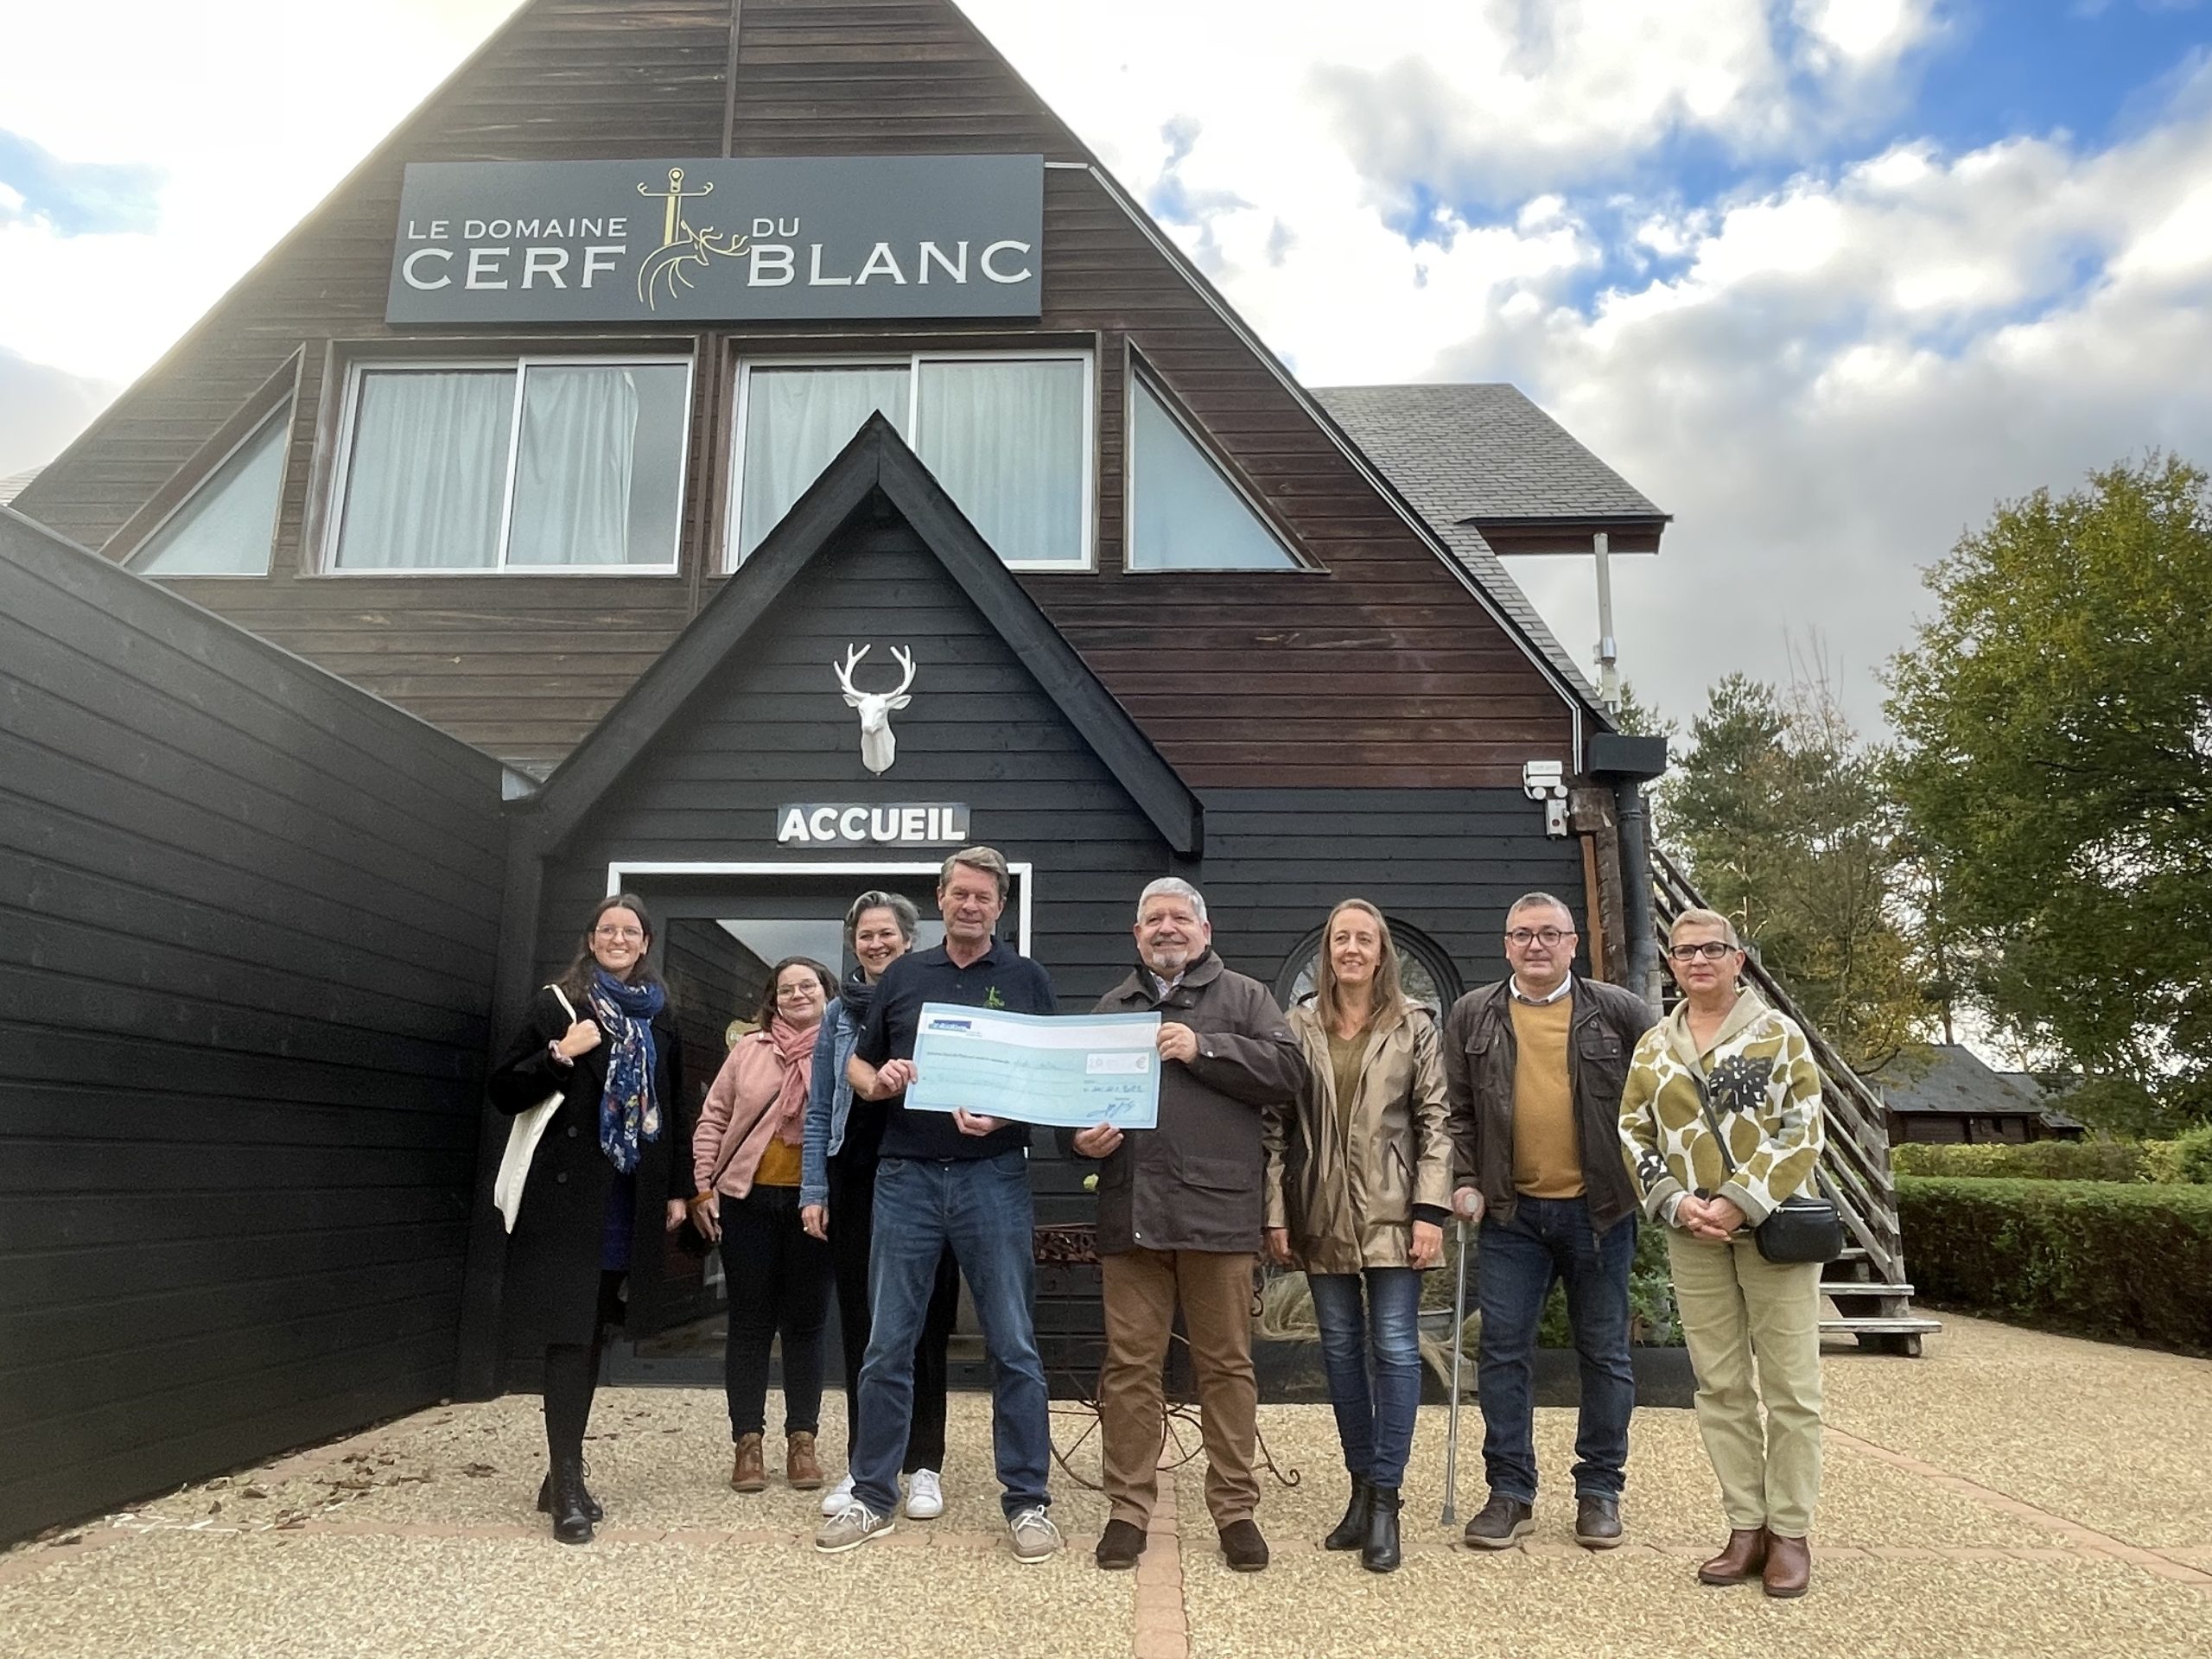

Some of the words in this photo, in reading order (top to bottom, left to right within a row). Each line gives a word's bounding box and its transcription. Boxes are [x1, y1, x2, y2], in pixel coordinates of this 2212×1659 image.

[408, 219, 448, 239] LE
[464, 218, 627, 238] DOMAINE
[753, 217, 800, 238] DU
[403, 245, 626, 290] CERF
[747, 240, 1033, 287] BLANC
[778, 807, 966, 842] ACCUEIL
